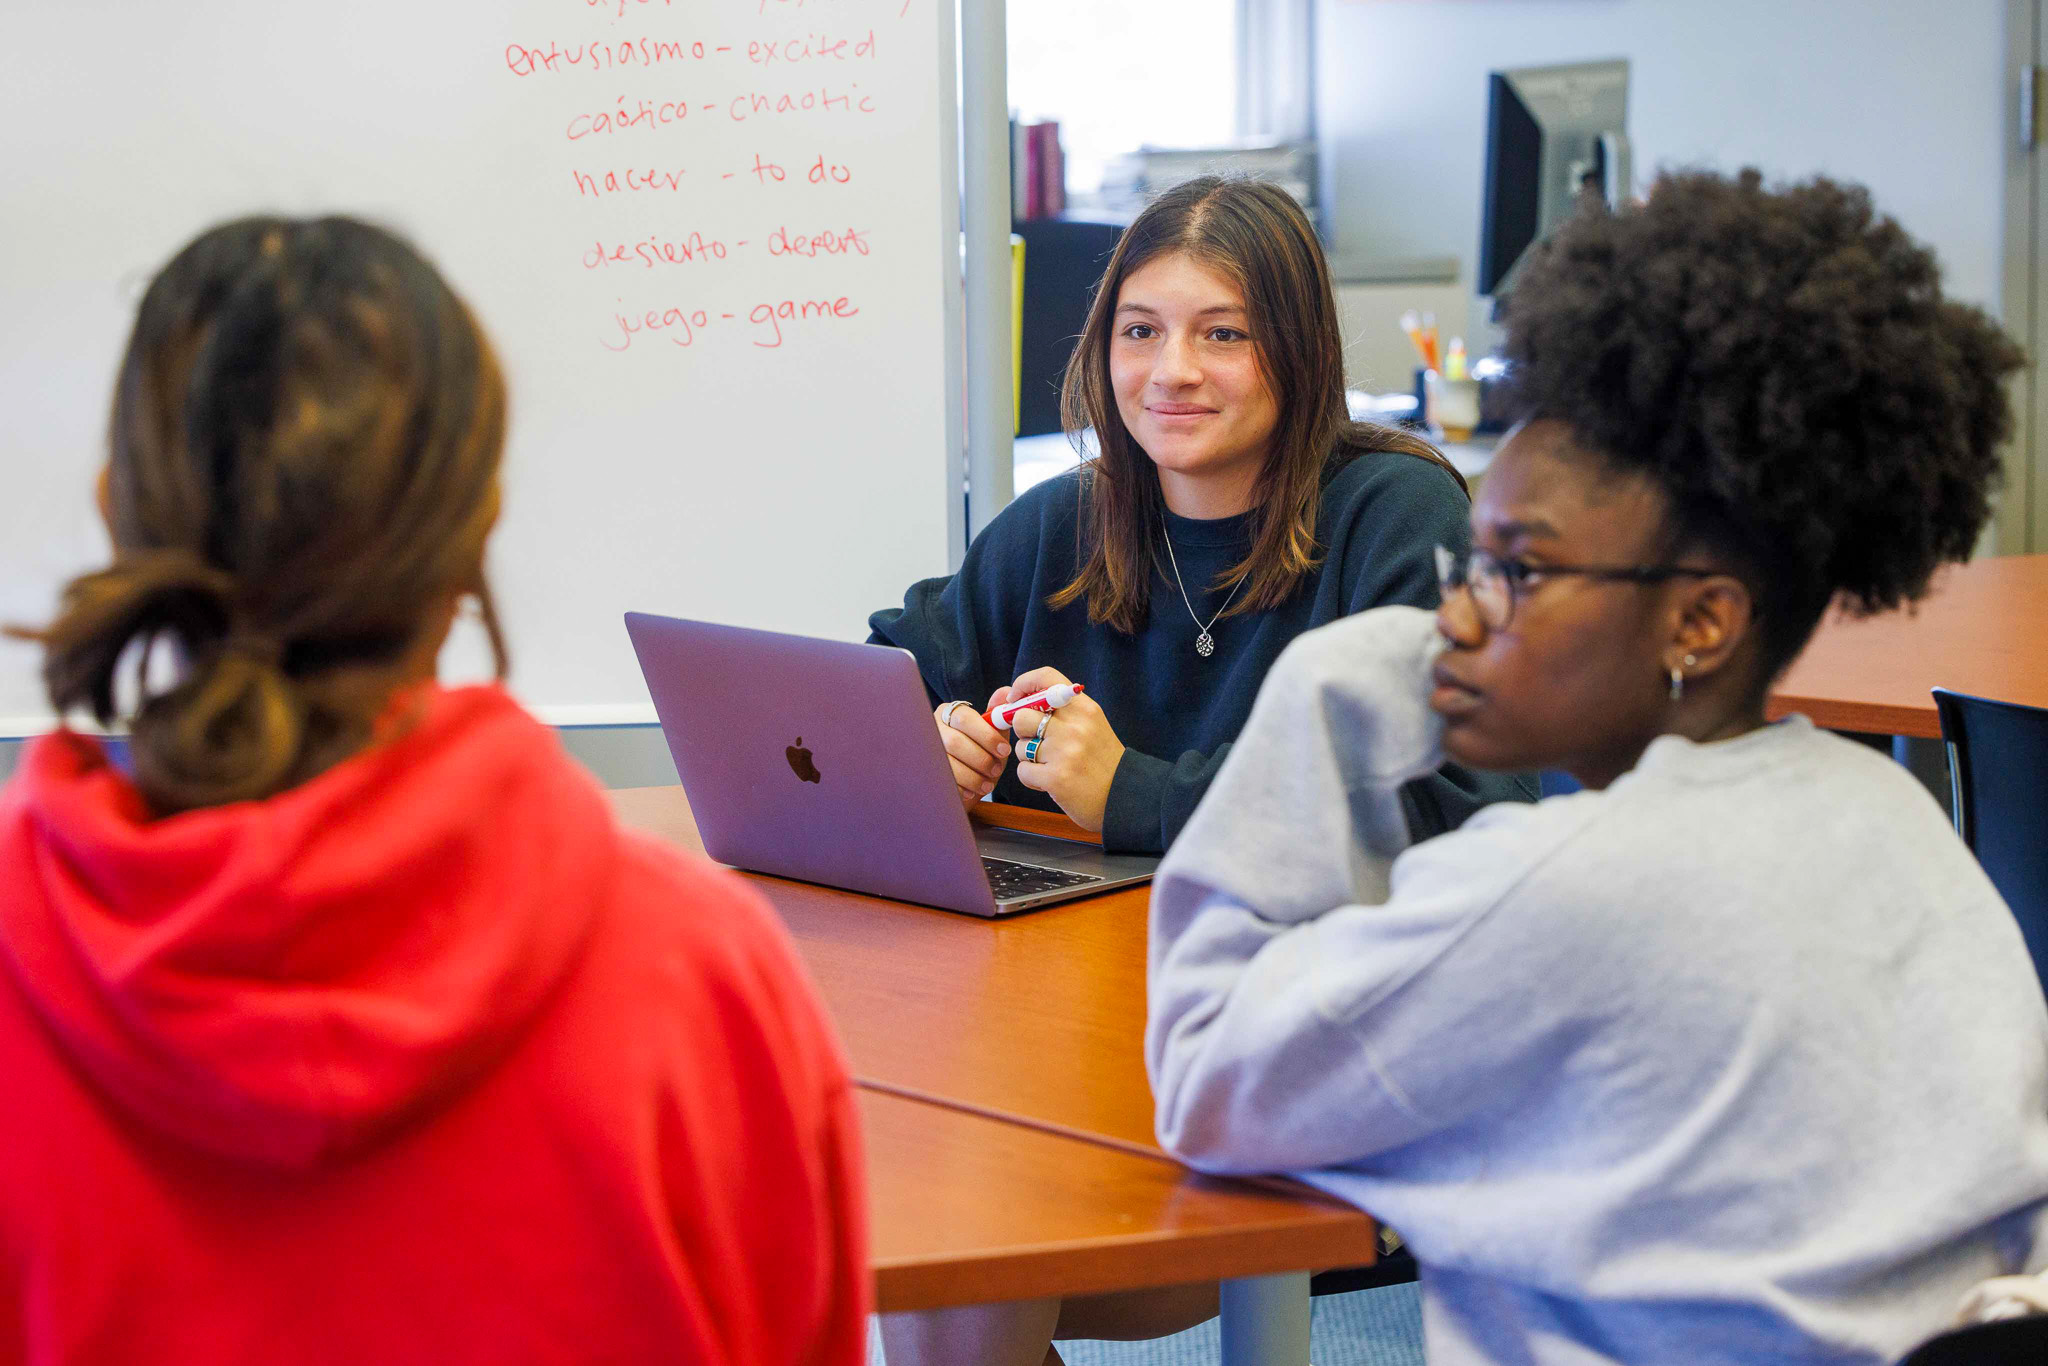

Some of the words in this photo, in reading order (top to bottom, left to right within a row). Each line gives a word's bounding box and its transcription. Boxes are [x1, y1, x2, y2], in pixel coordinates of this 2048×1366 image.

[504, 36, 705, 77] entusiasmo
[746, 29, 876, 66] excited
[566, 95, 689, 141] caótico
[729, 83, 876, 122] chaotic
[752, 152, 787, 184] to
[807, 153, 852, 184] do
[582, 231, 728, 270] desierto
[600, 297, 709, 352] juego
[748, 295, 860, 349] game
